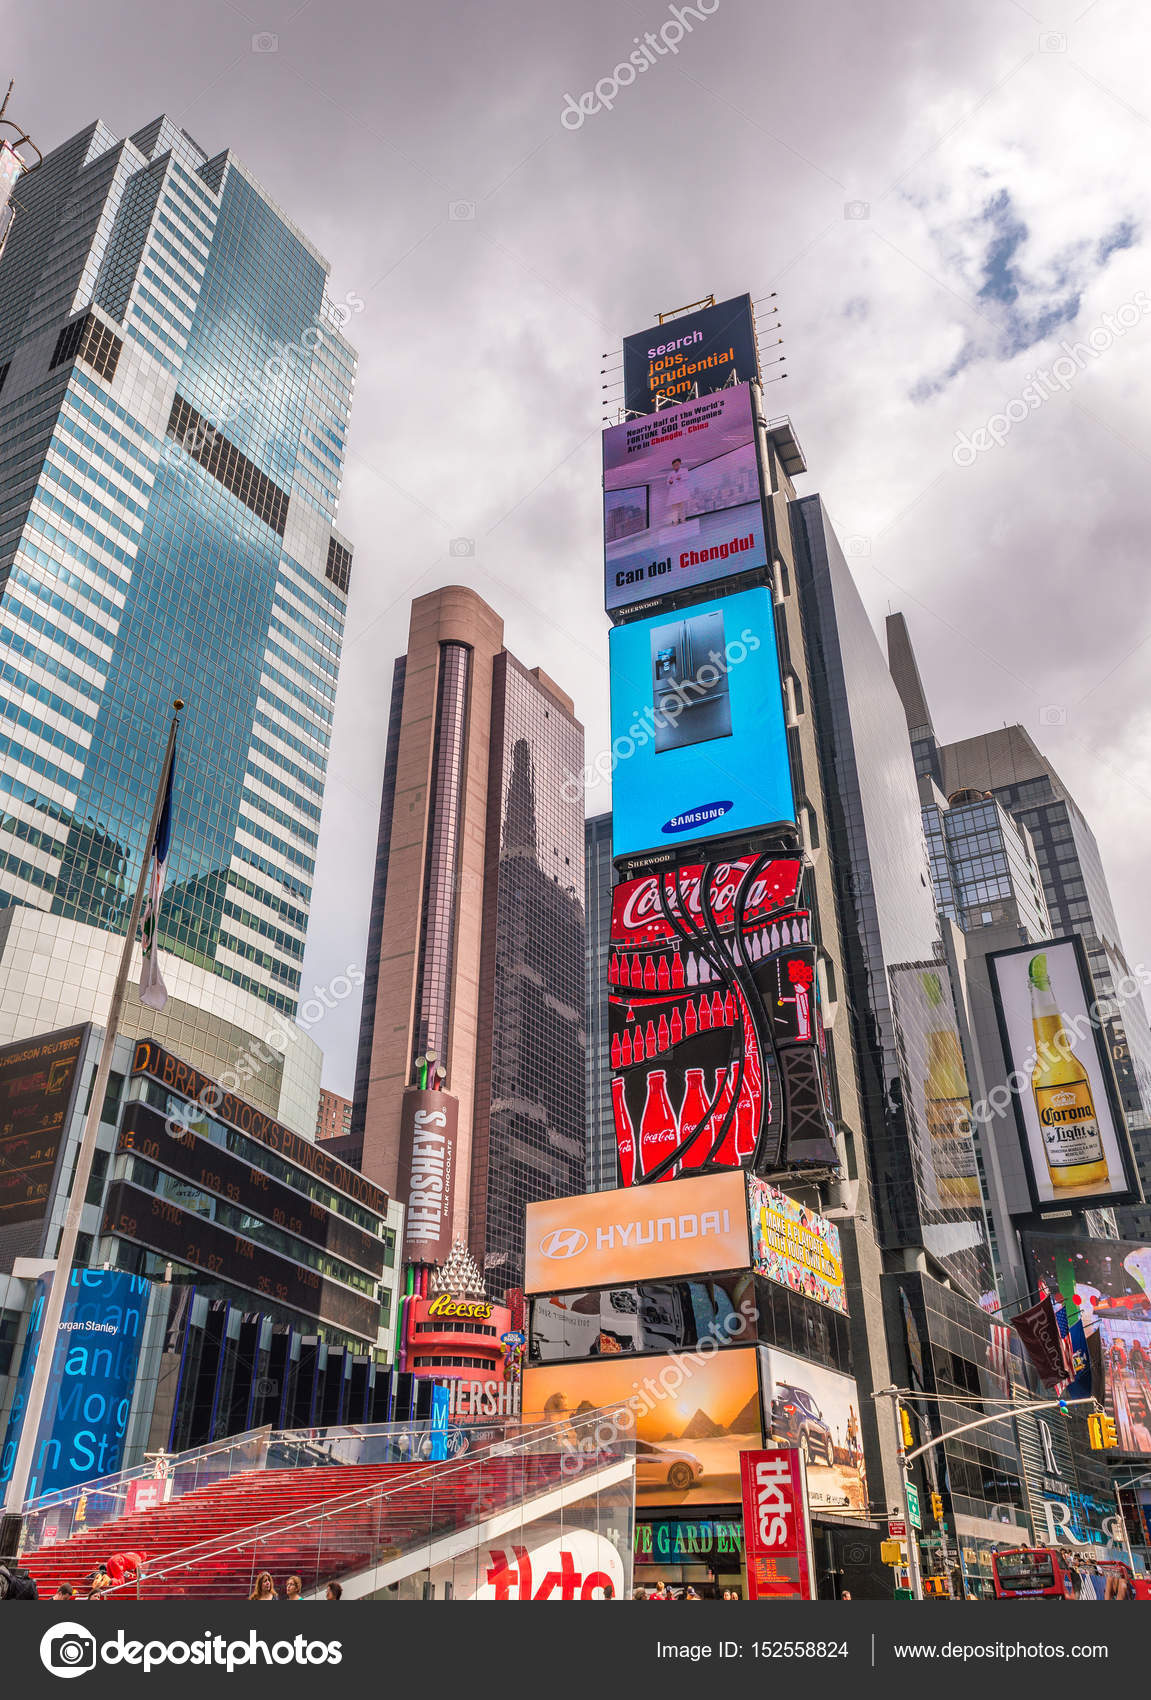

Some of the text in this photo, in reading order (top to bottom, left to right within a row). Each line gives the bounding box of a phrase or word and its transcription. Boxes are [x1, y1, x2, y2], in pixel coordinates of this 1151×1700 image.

[648, 330, 703, 359] search
[649, 353, 689, 376] jobs.
[650, 347, 734, 390] prudential
[627, 400, 725, 438] Nearly Half of the World's
[627, 409, 722, 445] FORTUNE 500 Companies
[627, 444, 641, 454] Are
[643, 440, 650, 448] in
[688, 422, 709, 434] China
[615, 533, 755, 587] Can do! Chengdu!
[670, 806, 725, 828] SAMSUNG
[1041, 1104, 1094, 1127] Corona
[1054, 1125, 1086, 1142] Light
[222, 1092, 279, 1148] STOCKS
[282, 1133, 331, 1181] PLUNGE
[333, 1164, 351, 1190] ON
[406, 1109, 447, 1241] HERSHEY'S
[445, 1139, 453, 1193] CHOCOLATE
[596, 1209, 730, 1250] HYUNDAI
[765, 1209, 786, 1237] MAKE
[793, 1226, 825, 1259] PLAYDATE
[767, 1227, 787, 1255] WITH
[786, 1238, 805, 1265] YOUR
[805, 1249, 821, 1272] OWN
[428, 1293, 495, 1319] Reese's
[57, 1320, 119, 1336] organ Stanley
[755, 1457, 793, 1546] tkts
[657, 1524, 741, 1554] GARDEN
